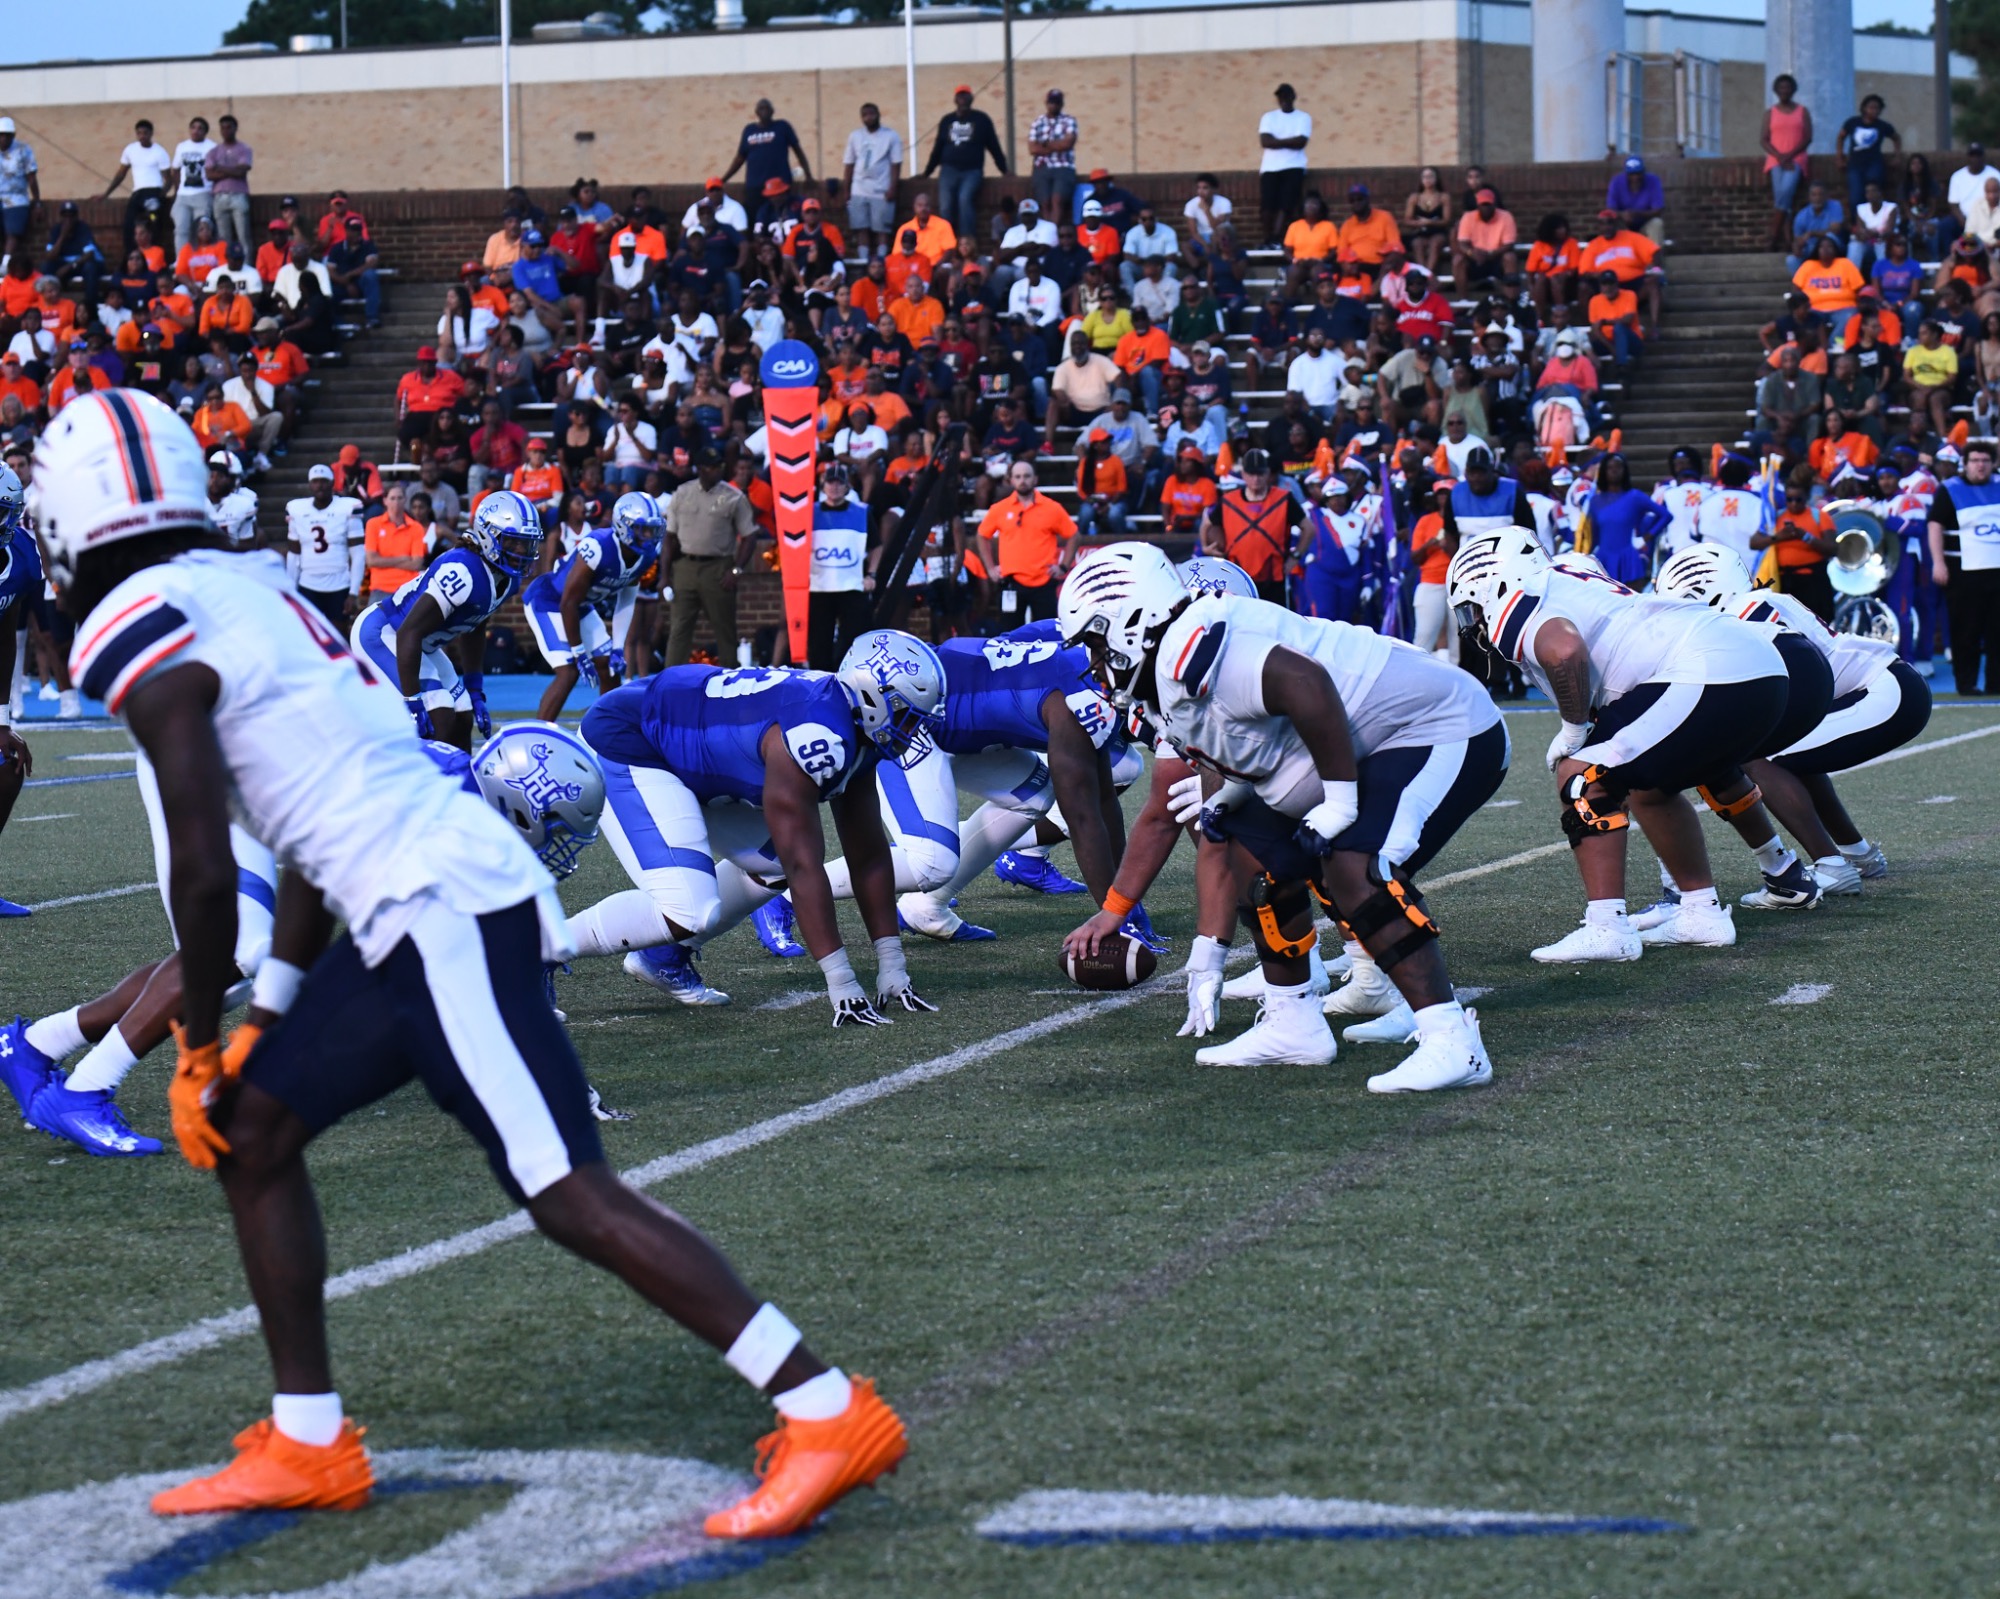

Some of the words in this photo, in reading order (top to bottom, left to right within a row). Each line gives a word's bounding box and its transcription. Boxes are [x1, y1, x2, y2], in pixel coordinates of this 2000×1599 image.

[772, 359, 806, 374] CAA
[311, 526, 329, 554] 3
[815, 547, 852, 561] CAA
[440, 570, 466, 597] 24
[1075, 702, 1107, 735] 96
[798, 738, 836, 774] 93
[1083, 960, 1114, 969] Wilson
